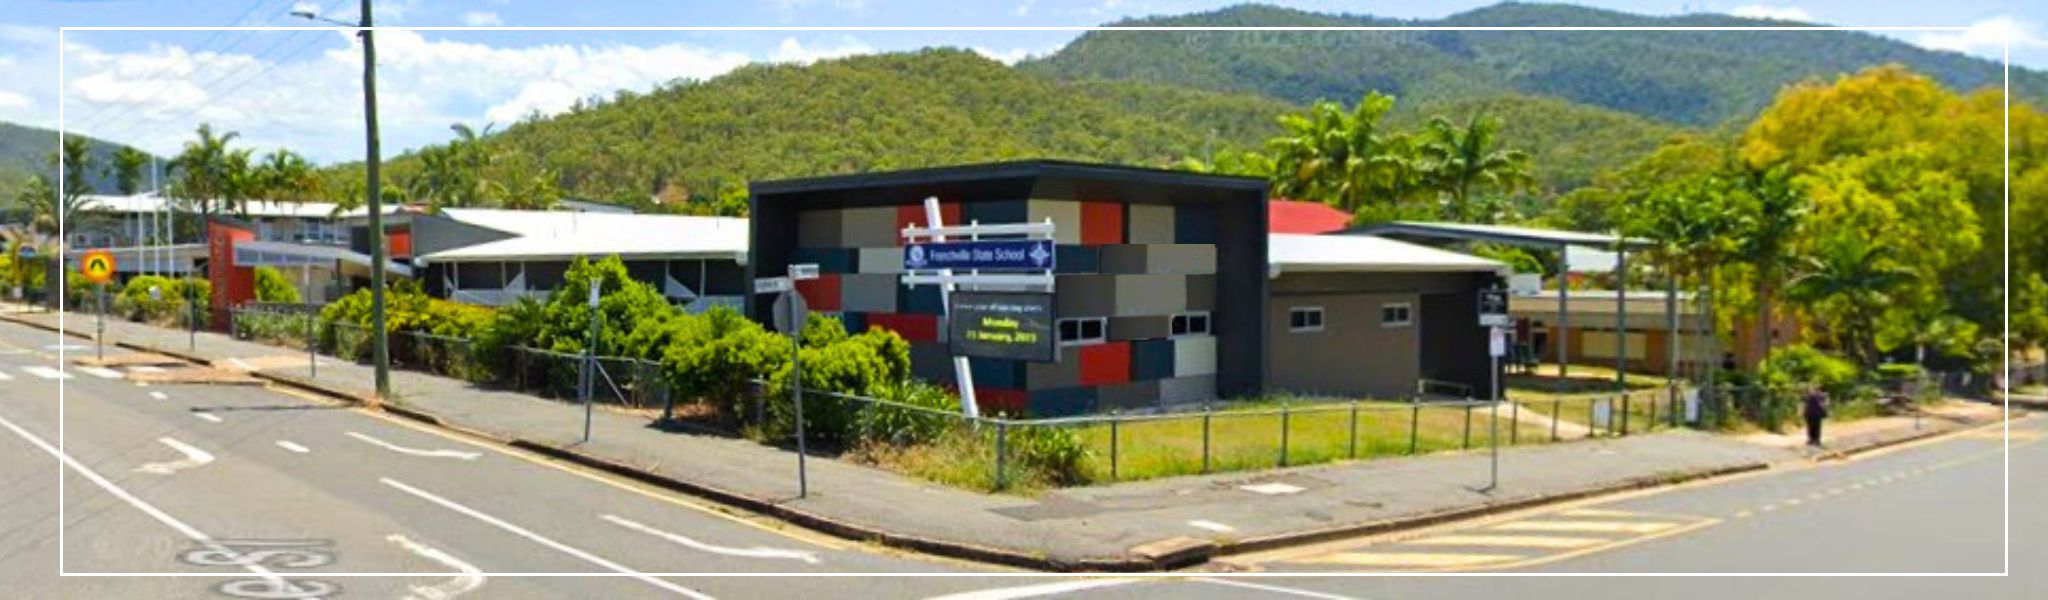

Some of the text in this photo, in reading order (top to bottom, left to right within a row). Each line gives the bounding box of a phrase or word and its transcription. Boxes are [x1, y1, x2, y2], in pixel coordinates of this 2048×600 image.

[973, 248, 993, 261] State
[994, 247, 1025, 261] School
[982, 317, 1019, 329] Monday
